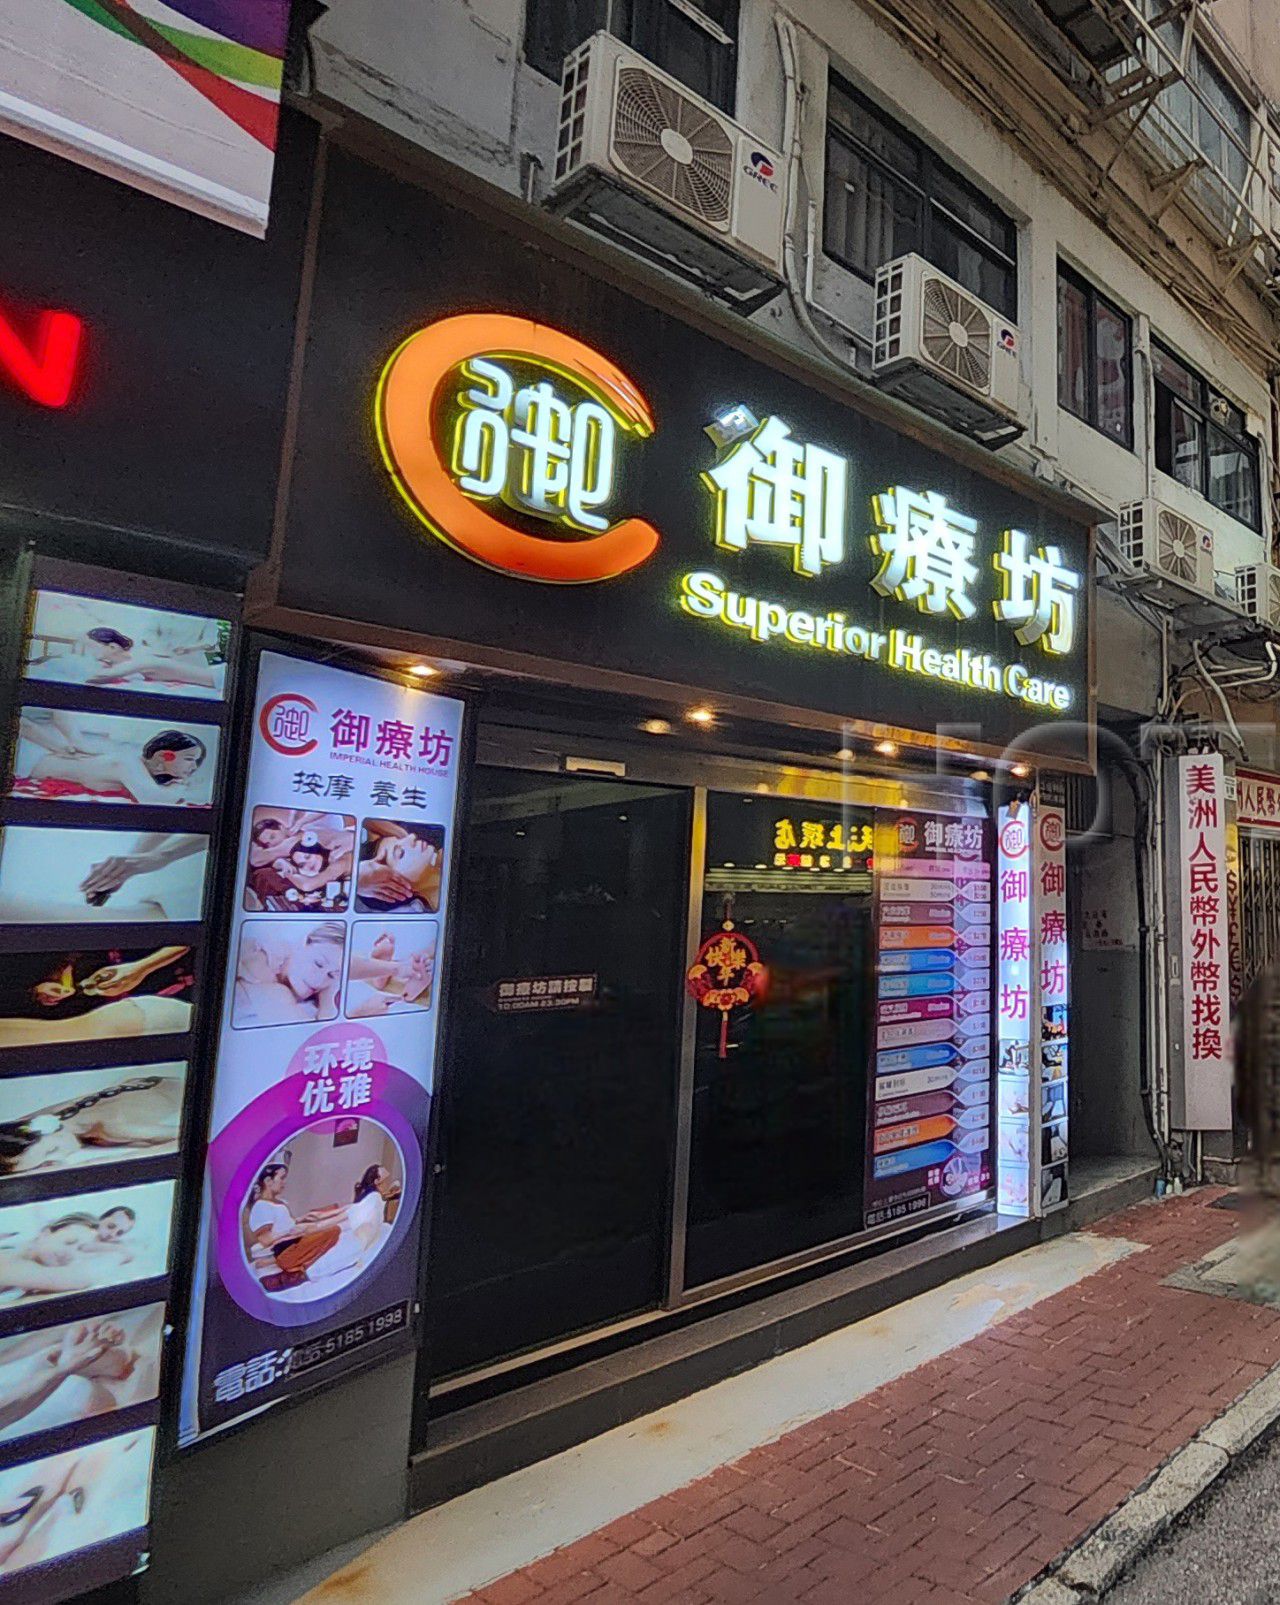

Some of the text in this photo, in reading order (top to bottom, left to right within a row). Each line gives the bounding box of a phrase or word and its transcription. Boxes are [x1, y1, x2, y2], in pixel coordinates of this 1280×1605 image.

[743, 165, 778, 194] GREE
[700, 414, 1082, 654] 御療坊
[681, 569, 1072, 712] Superior Health Care
[329, 707, 454, 767] 御療坊
[330, 751, 377, 768] IMPERIAL
[379, 759, 416, 774] HEALTH
[292, 769, 428, 810] 按摩 養生
[924, 820, 983, 849] 御療坊
[1040, 861, 1067, 996] 御療坊
[1186, 763, 1223, 1060] 美洲人民幣外幣找換
[1000, 870, 1028, 1021] 御療坊
[302, 1039, 374, 1078] 环境
[300, 1072, 372, 1117] 优雅
